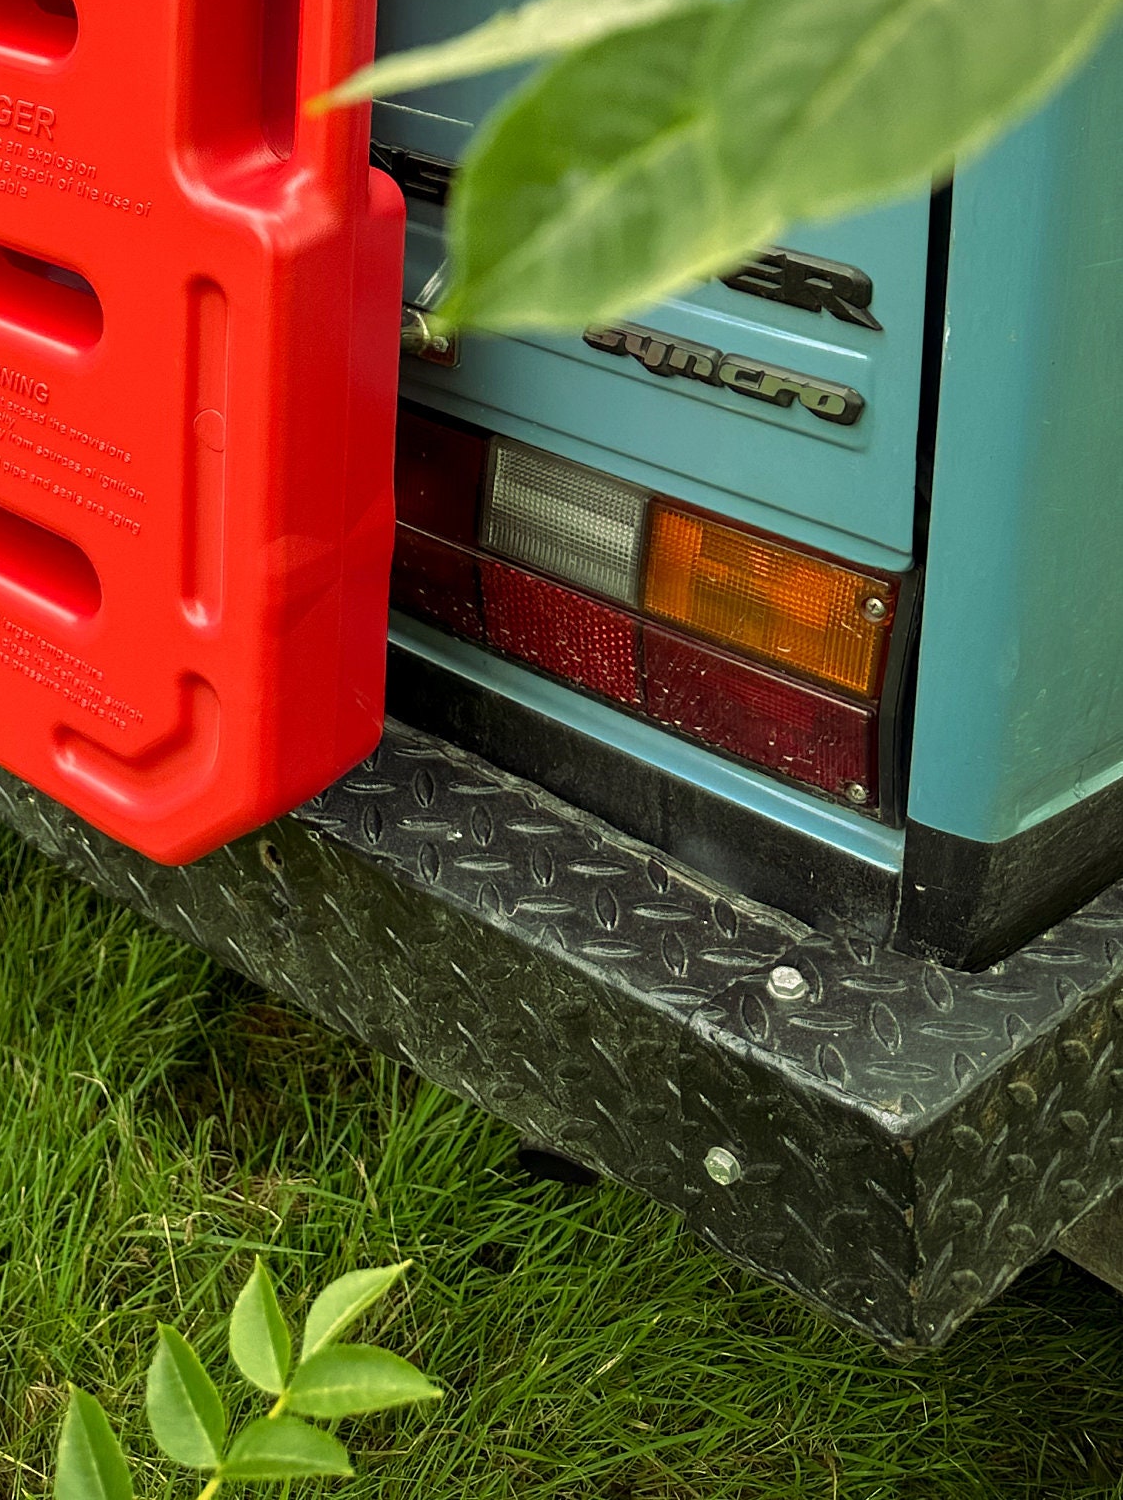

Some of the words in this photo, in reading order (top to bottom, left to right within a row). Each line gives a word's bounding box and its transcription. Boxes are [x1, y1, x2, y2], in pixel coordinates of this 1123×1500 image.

[6, 141, 23, 156] an
[27, 146, 97, 179] explosion
[15, 163, 54, 187] reach
[57, 176, 74, 191] of
[77, 181, 99, 201] the
[103, 191, 131, 211] use
[135, 201, 153, 218] of
[582, 319, 866, 426] syncro
[69, 427, 132, 463] provisions
